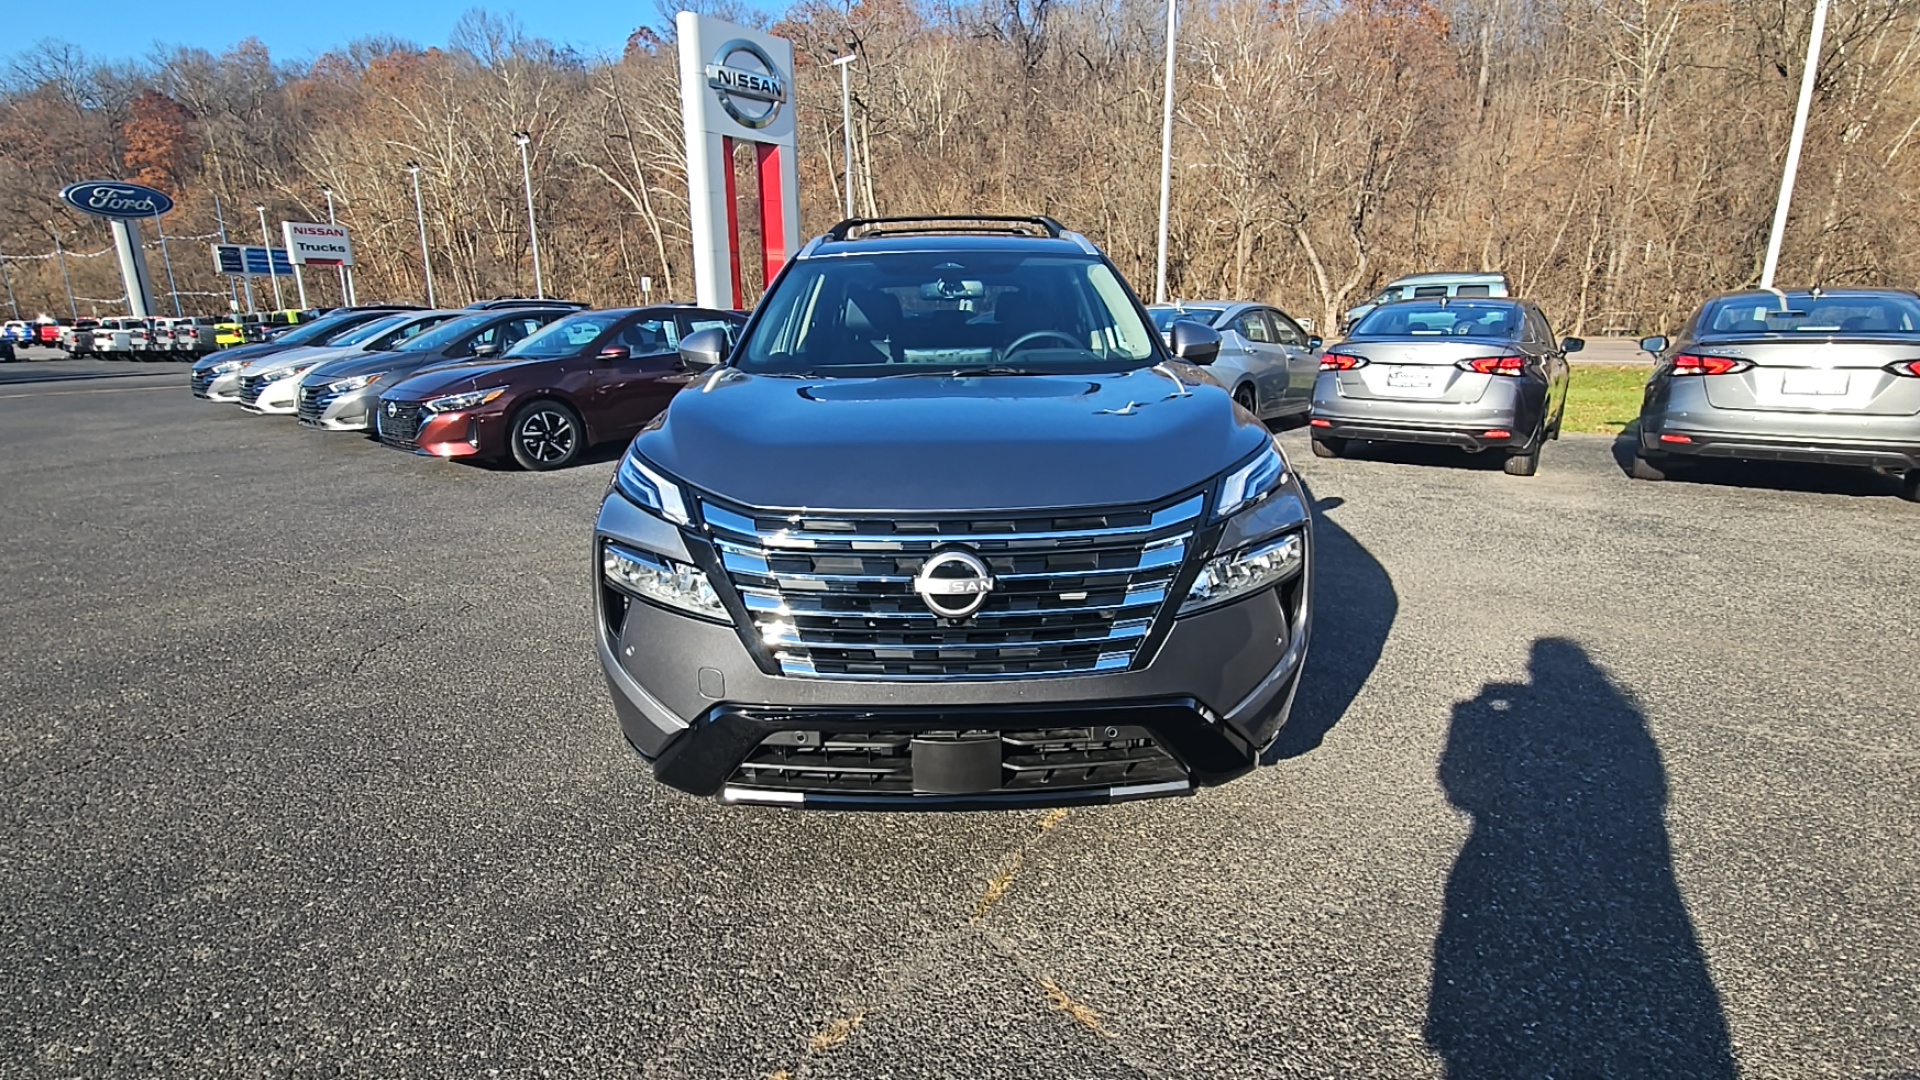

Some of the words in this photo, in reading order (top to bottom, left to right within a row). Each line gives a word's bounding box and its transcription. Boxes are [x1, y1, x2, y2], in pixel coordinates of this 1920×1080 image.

[717, 69, 782, 97] NISSAN
[88, 186, 153, 211] Ford
[293, 226, 345, 237] NISSAN
[296, 241, 346, 253] Trucks
